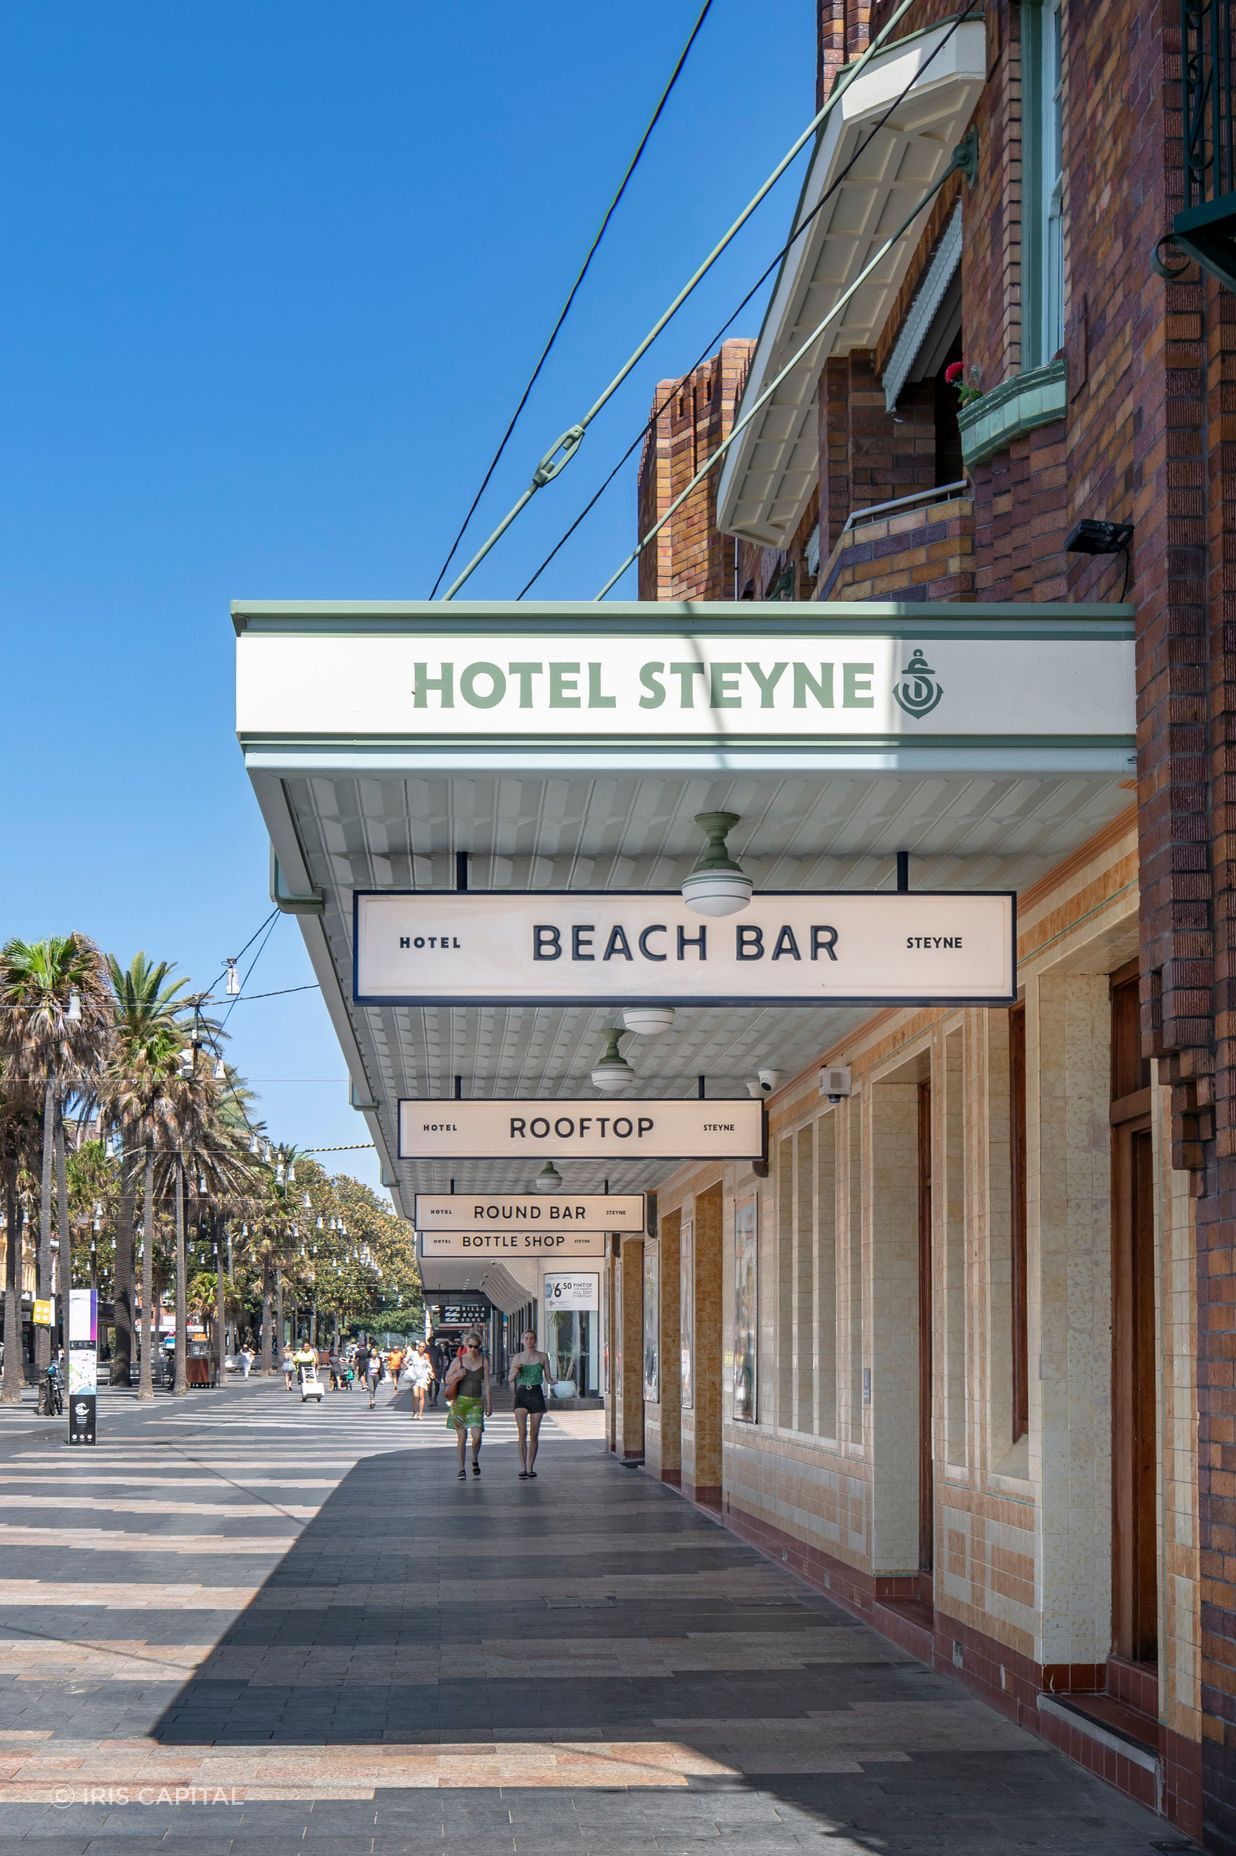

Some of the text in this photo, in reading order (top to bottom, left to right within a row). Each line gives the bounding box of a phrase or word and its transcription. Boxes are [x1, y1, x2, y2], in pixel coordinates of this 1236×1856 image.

[413, 661, 875, 710] HOTEL STEYNE
[399, 936, 461, 950] HOTEL
[532, 924, 840, 963] BEACH BAR
[906, 937, 964, 950] STEYNE
[423, 1123, 458, 1132] HOTEL
[509, 1117, 655, 1138] ROOFTOP
[703, 1123, 735, 1132] STEYNE
[473, 1205, 586, 1220] ROUND BAR
[462, 1236, 566, 1247] BOTTLE SHOP
